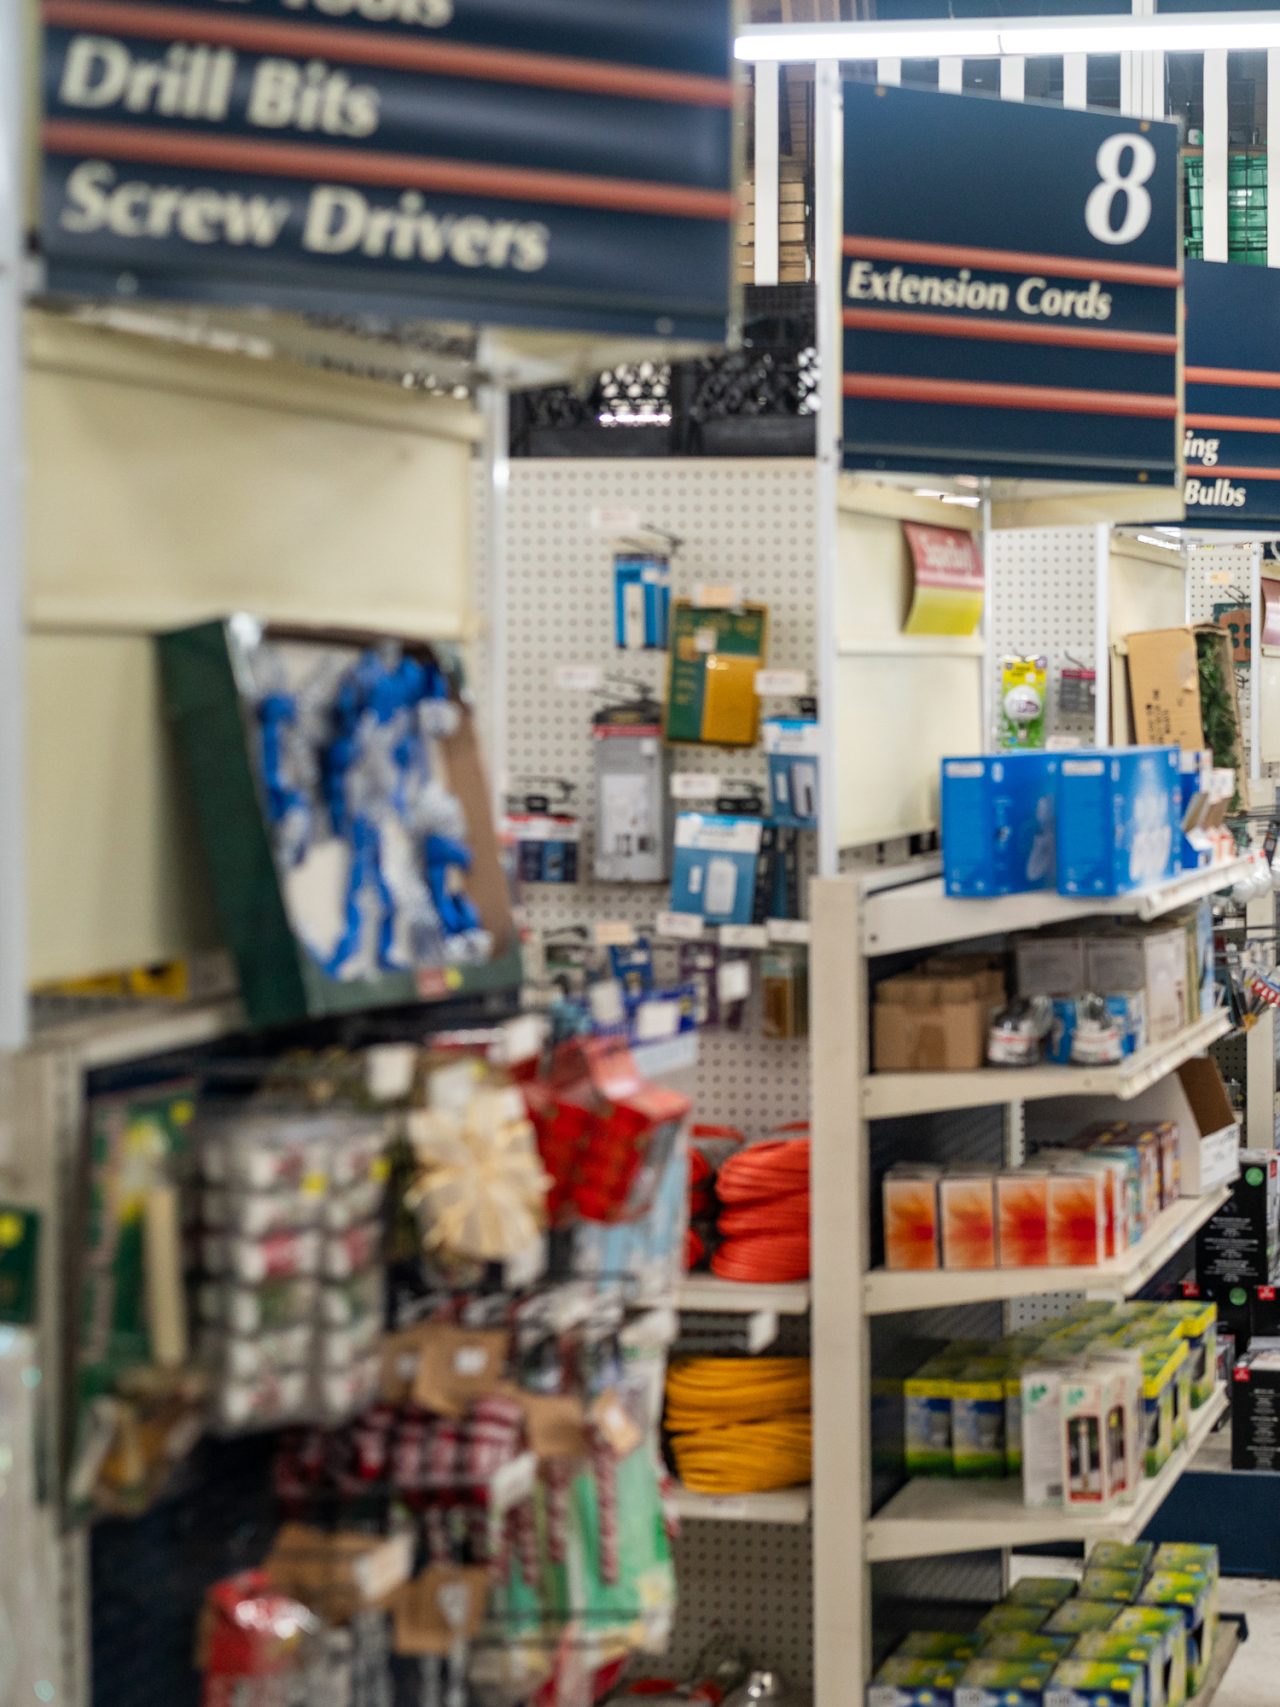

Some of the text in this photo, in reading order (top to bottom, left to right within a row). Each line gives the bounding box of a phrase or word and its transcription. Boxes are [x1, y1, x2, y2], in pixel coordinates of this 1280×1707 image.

[59, 33, 382, 138] Drill Bits
[60, 160, 550, 274] Screw Drivers
[1084, 133, 1157, 245] 8
[847, 259, 1113, 320] Extension Cords
[1184, 477, 1248, 508] Bulbs
